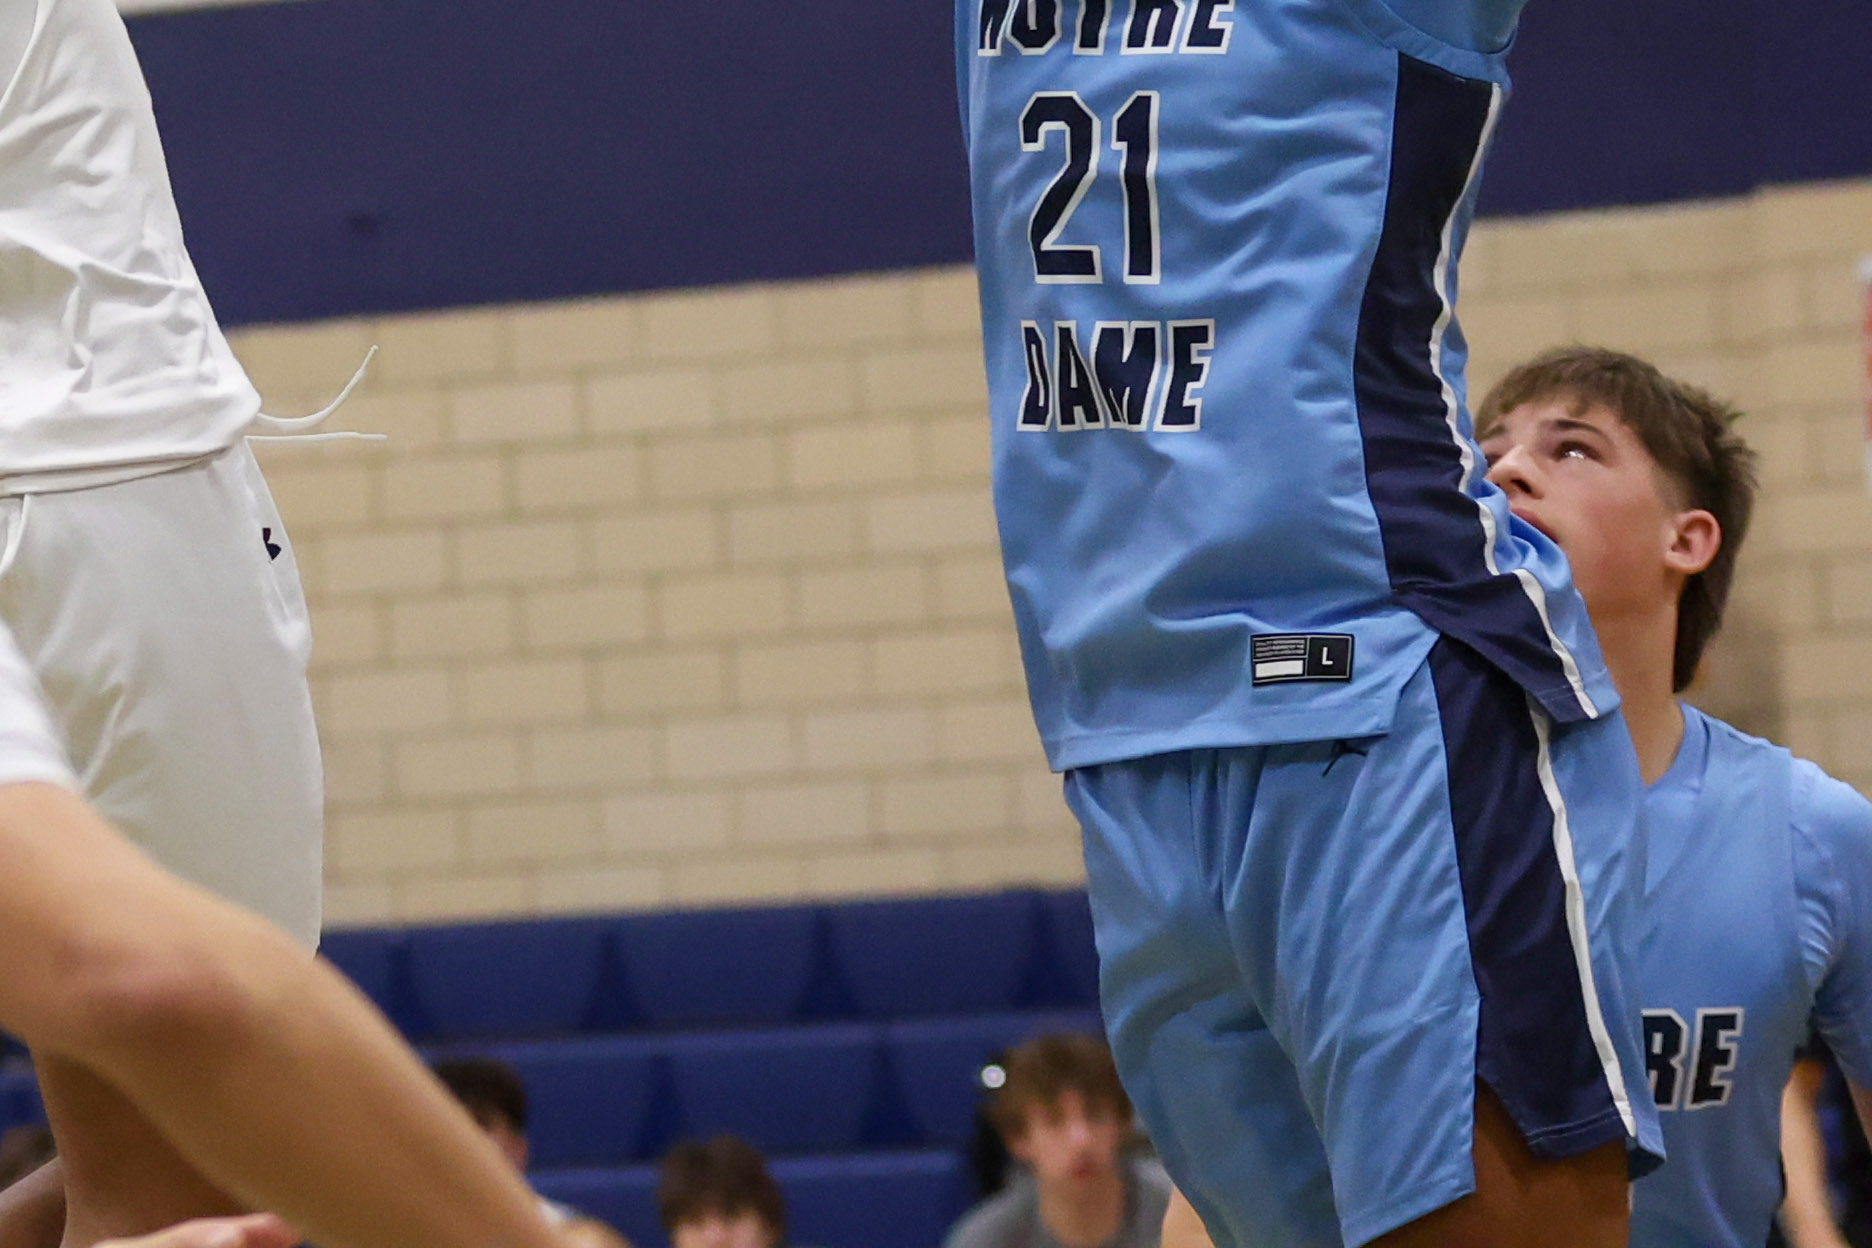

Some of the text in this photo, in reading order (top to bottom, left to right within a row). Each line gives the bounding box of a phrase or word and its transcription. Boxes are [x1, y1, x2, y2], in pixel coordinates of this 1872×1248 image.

[1018, 90, 1160, 284] 21
[1016, 317, 1215, 433] DAME
[1321, 646, 1334, 666] L
